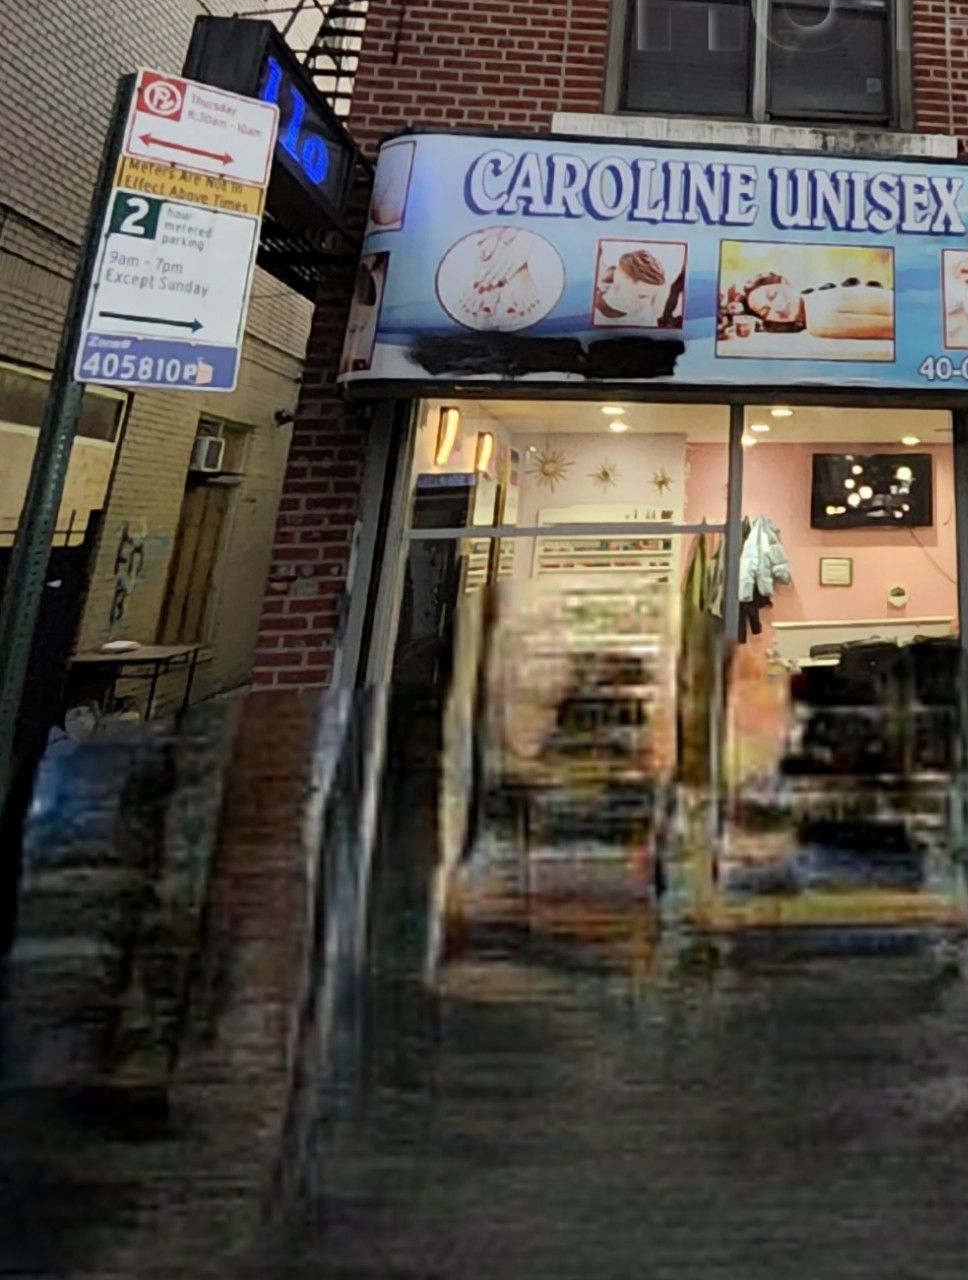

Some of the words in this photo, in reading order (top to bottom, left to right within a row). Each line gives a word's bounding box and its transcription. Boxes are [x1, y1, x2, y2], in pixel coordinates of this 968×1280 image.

[191, 94, 236, 116] Thursday
[237, 122, 261, 136] 10am
[129, 160, 175, 179] Meters
[181, 168, 201, 185] Are
[206, 176, 227, 191] Not
[125, 175, 165, 196] Effect
[169, 185, 209, 202] Above
[214, 192, 248, 212] Times
[464, 149, 758, 225] CAROLINE
[770, 167, 967, 234] UNISEX
[120, 197, 150, 235] 2
[166, 208, 193, 221] hour
[164, 222, 214, 238] metered
[162, 235, 205, 252] parking
[110, 251, 140, 267] 9am
[156, 258, 184, 274] 7pm
[105, 267, 155, 289] Except
[158, 276, 209, 298] Sunday
[83, 352, 181, 382] 405810
